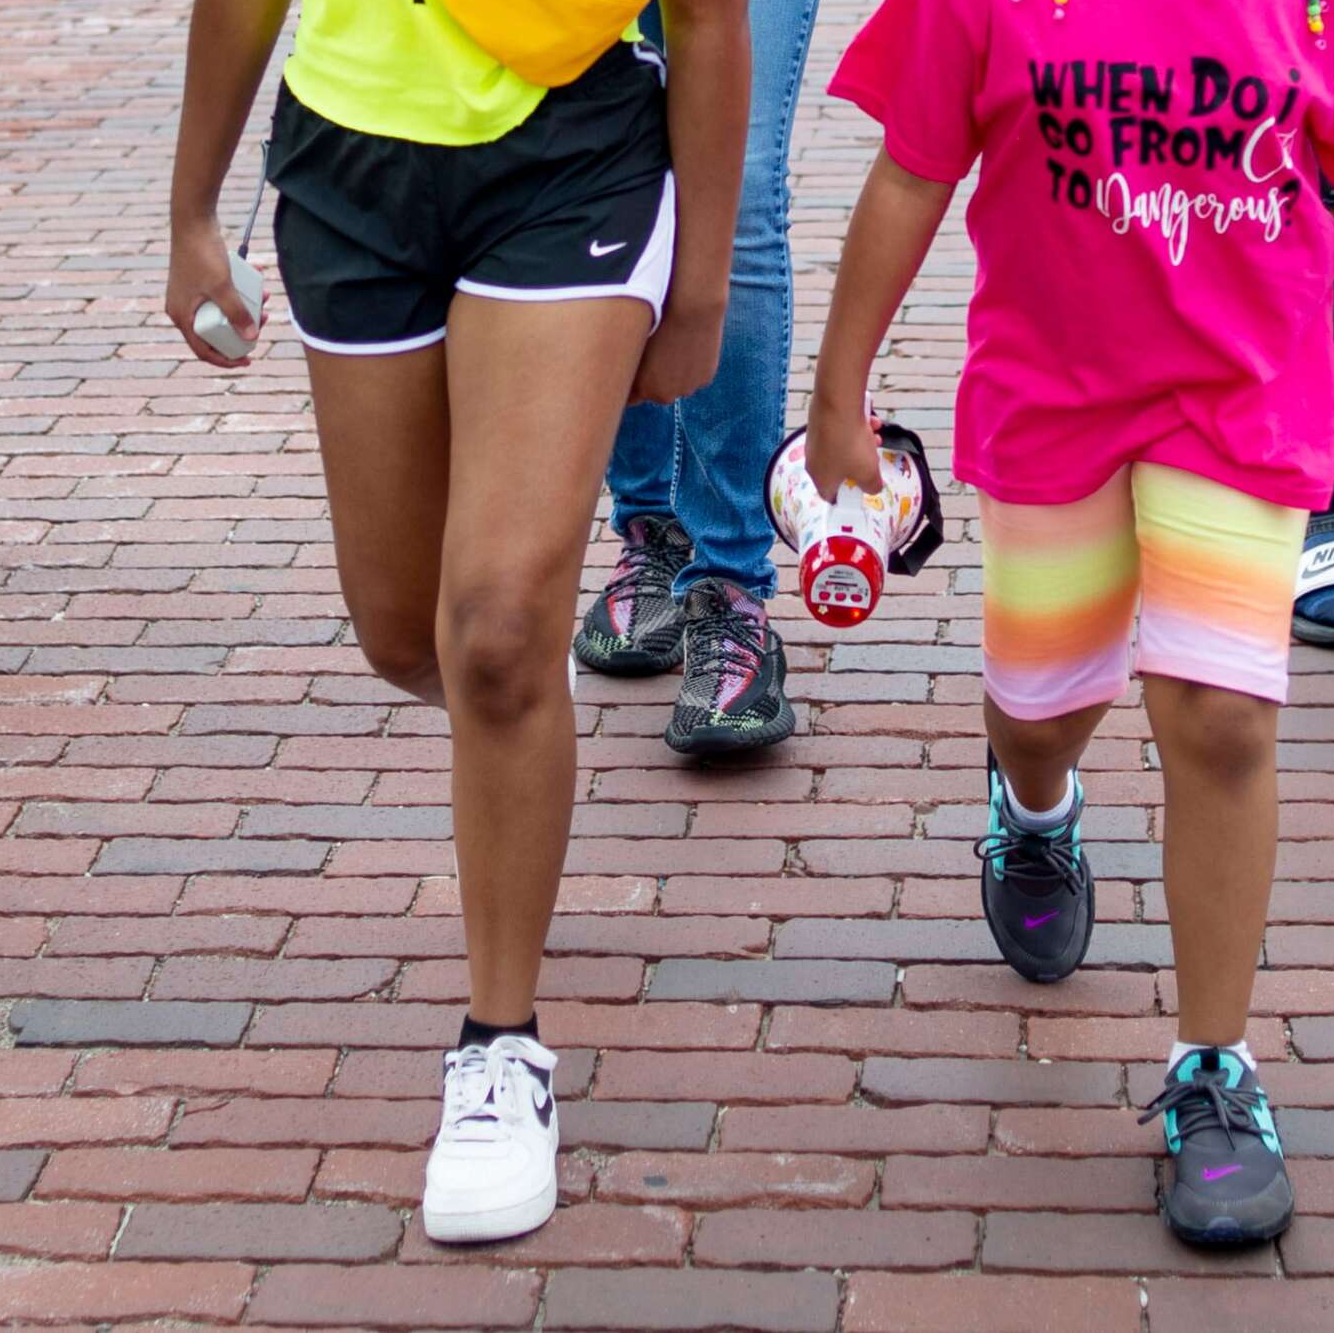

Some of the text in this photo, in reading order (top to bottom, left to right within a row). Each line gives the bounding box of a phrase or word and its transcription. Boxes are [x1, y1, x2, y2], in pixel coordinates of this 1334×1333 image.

[1029, 59, 1174, 113] WHEN
[1109, 115, 1245, 172] FROM
[1046, 158, 1092, 210] TO
